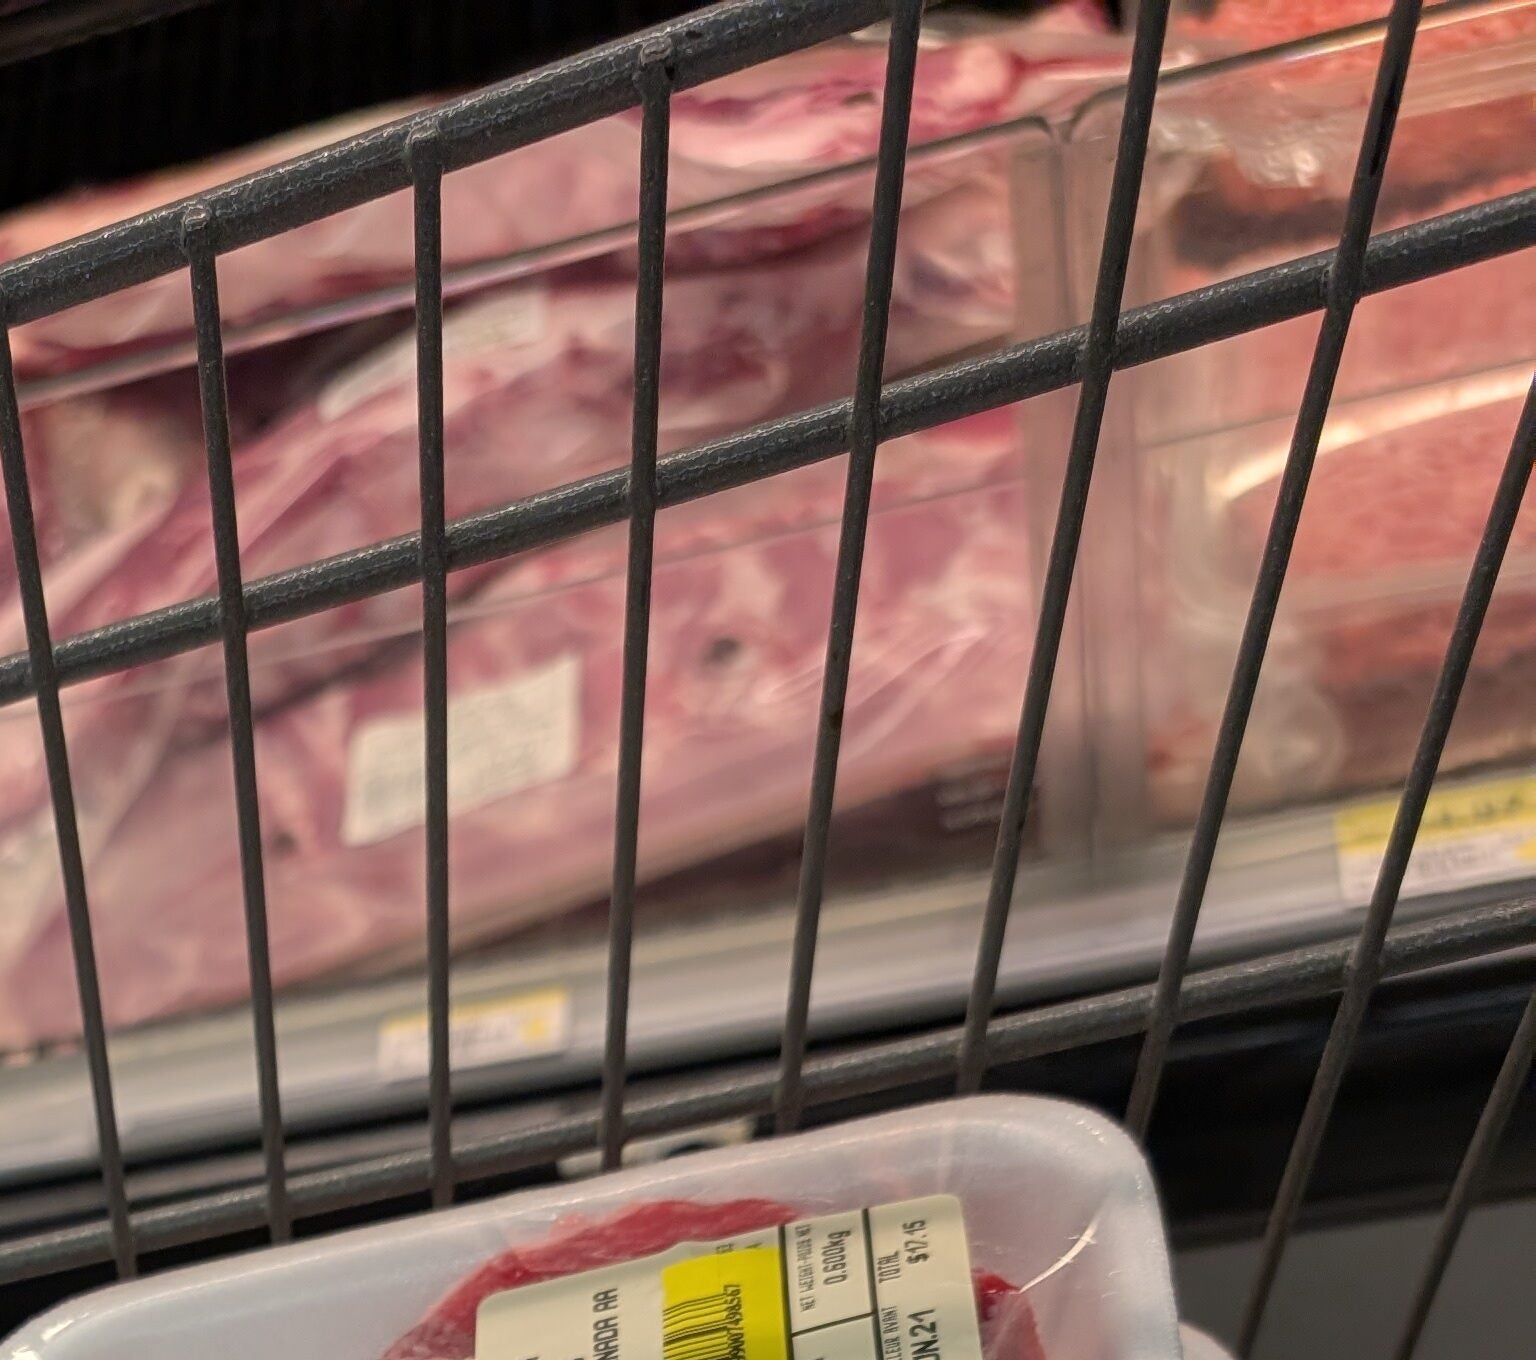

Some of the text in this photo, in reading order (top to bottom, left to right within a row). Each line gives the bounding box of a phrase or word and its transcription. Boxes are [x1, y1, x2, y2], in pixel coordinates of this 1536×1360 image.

[821, 1228, 851, 1285] 0.600kg
[902, 1218, 930, 1264] $17.15
[877, 1251, 901, 1284] TOTAL
[592, 1287, 618, 1313] AA
[799, 1295, 817, 1312] NET
[881, 1306, 899, 1335] AVANT
